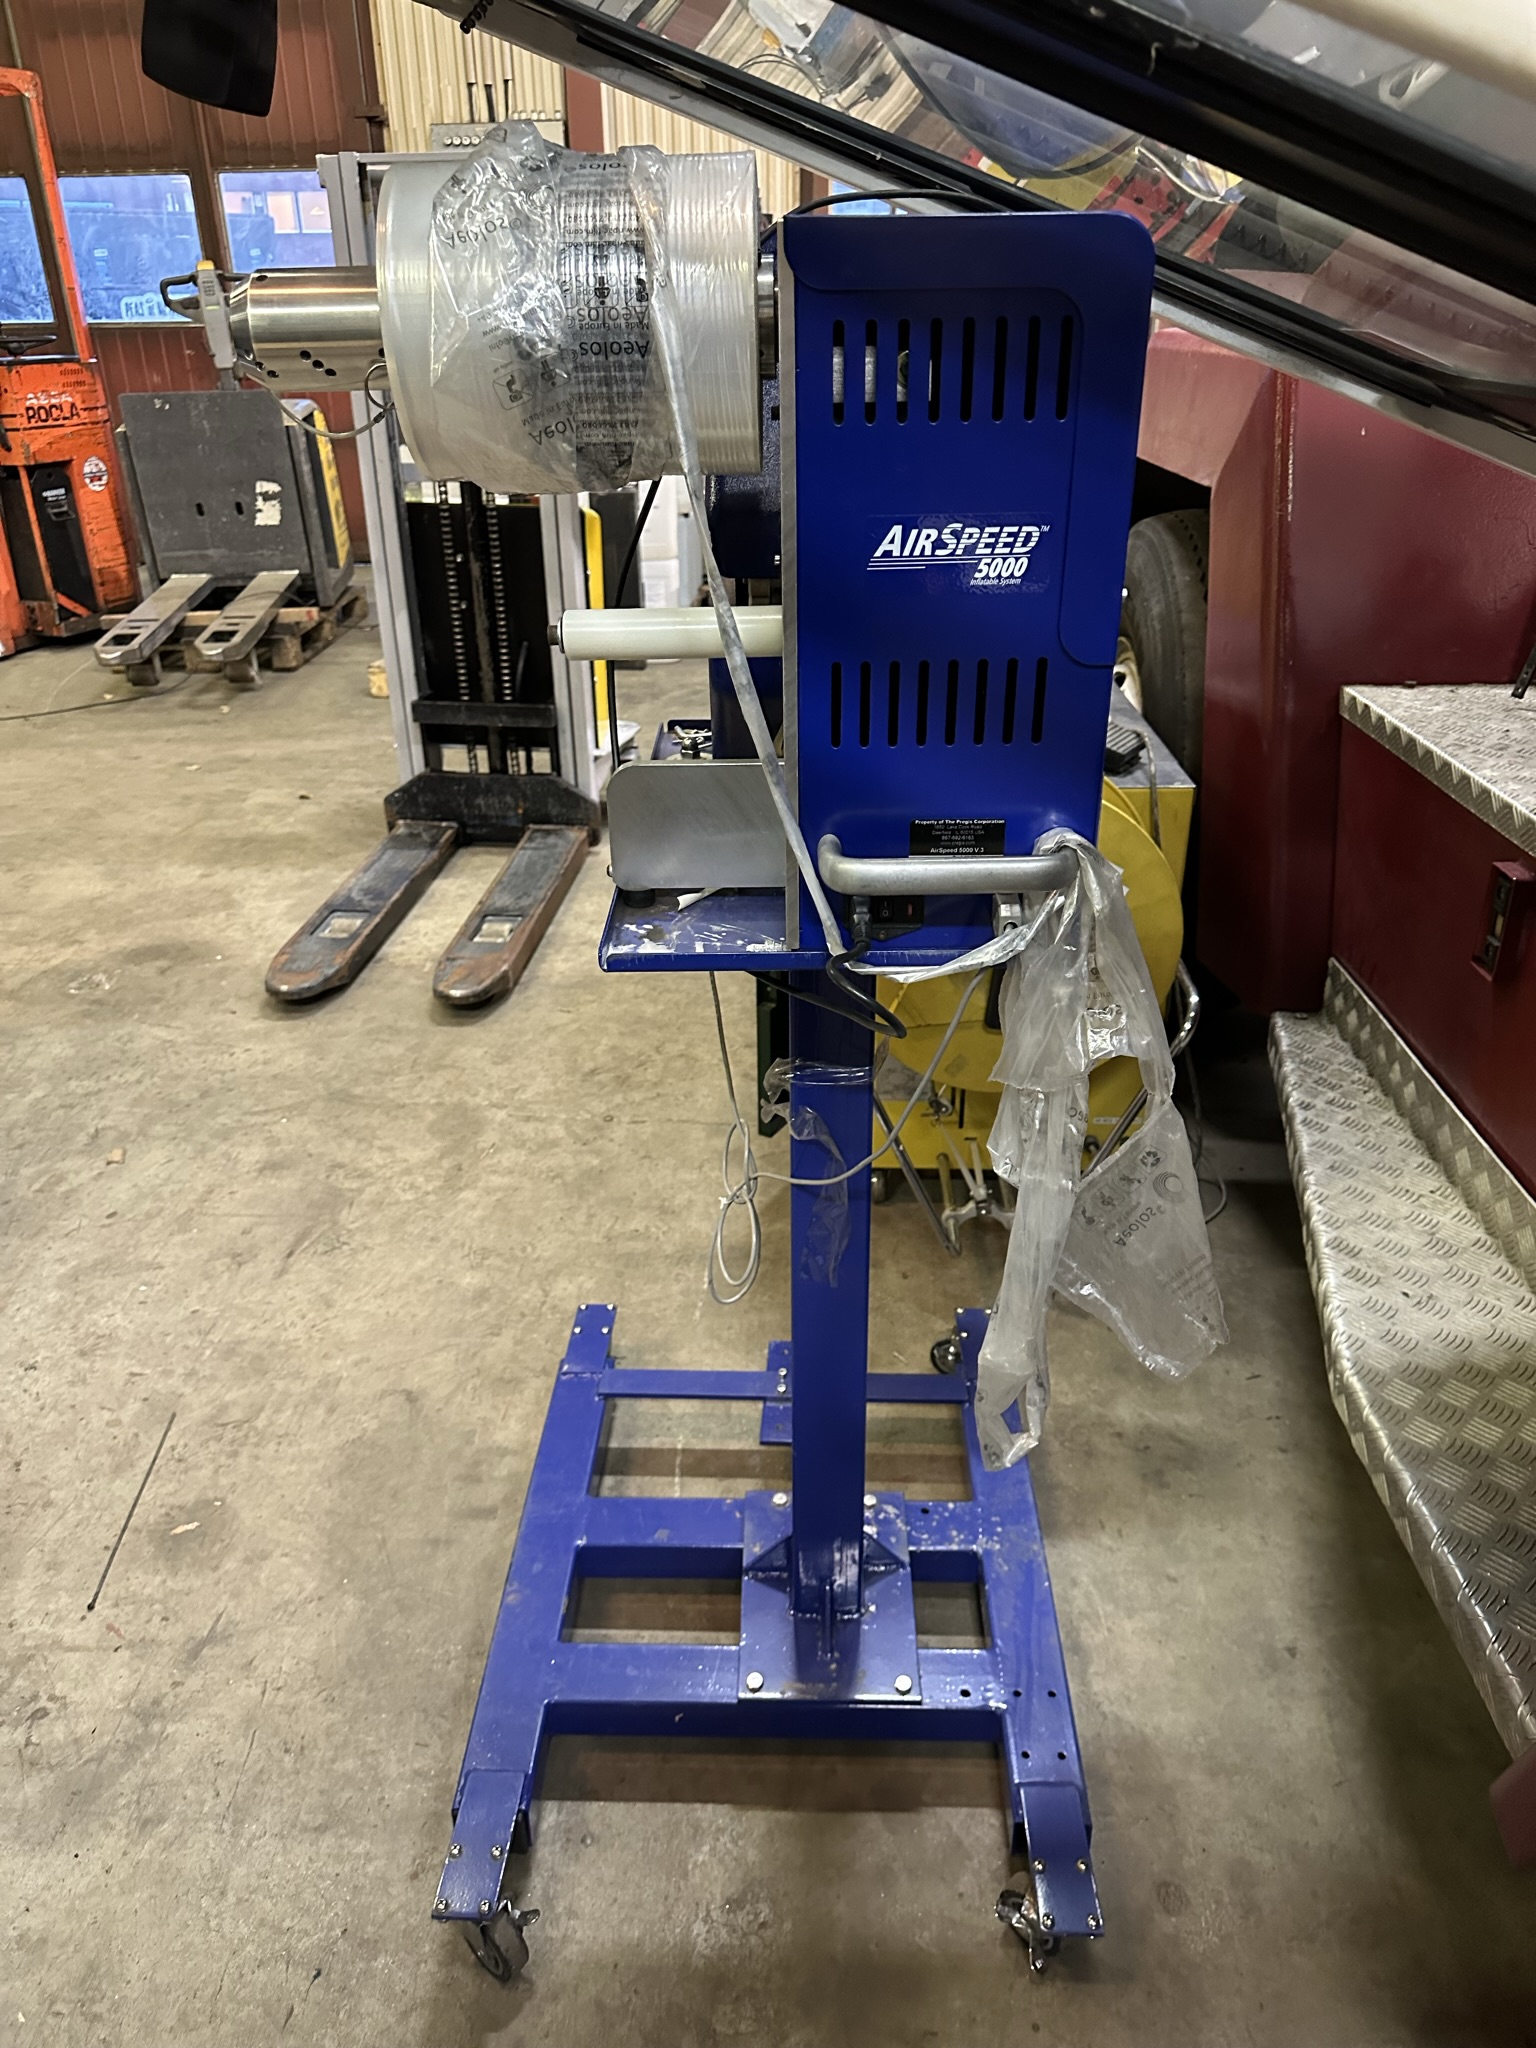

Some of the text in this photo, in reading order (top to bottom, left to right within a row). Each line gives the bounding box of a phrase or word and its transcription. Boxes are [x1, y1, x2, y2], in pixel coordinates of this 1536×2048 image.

[26, 403, 80, 424] ROCLA
[974, 557, 1029, 578] 5000
[970, 577, 1022, 586] Inflatable System
[915, 819, 938, 827] Property
